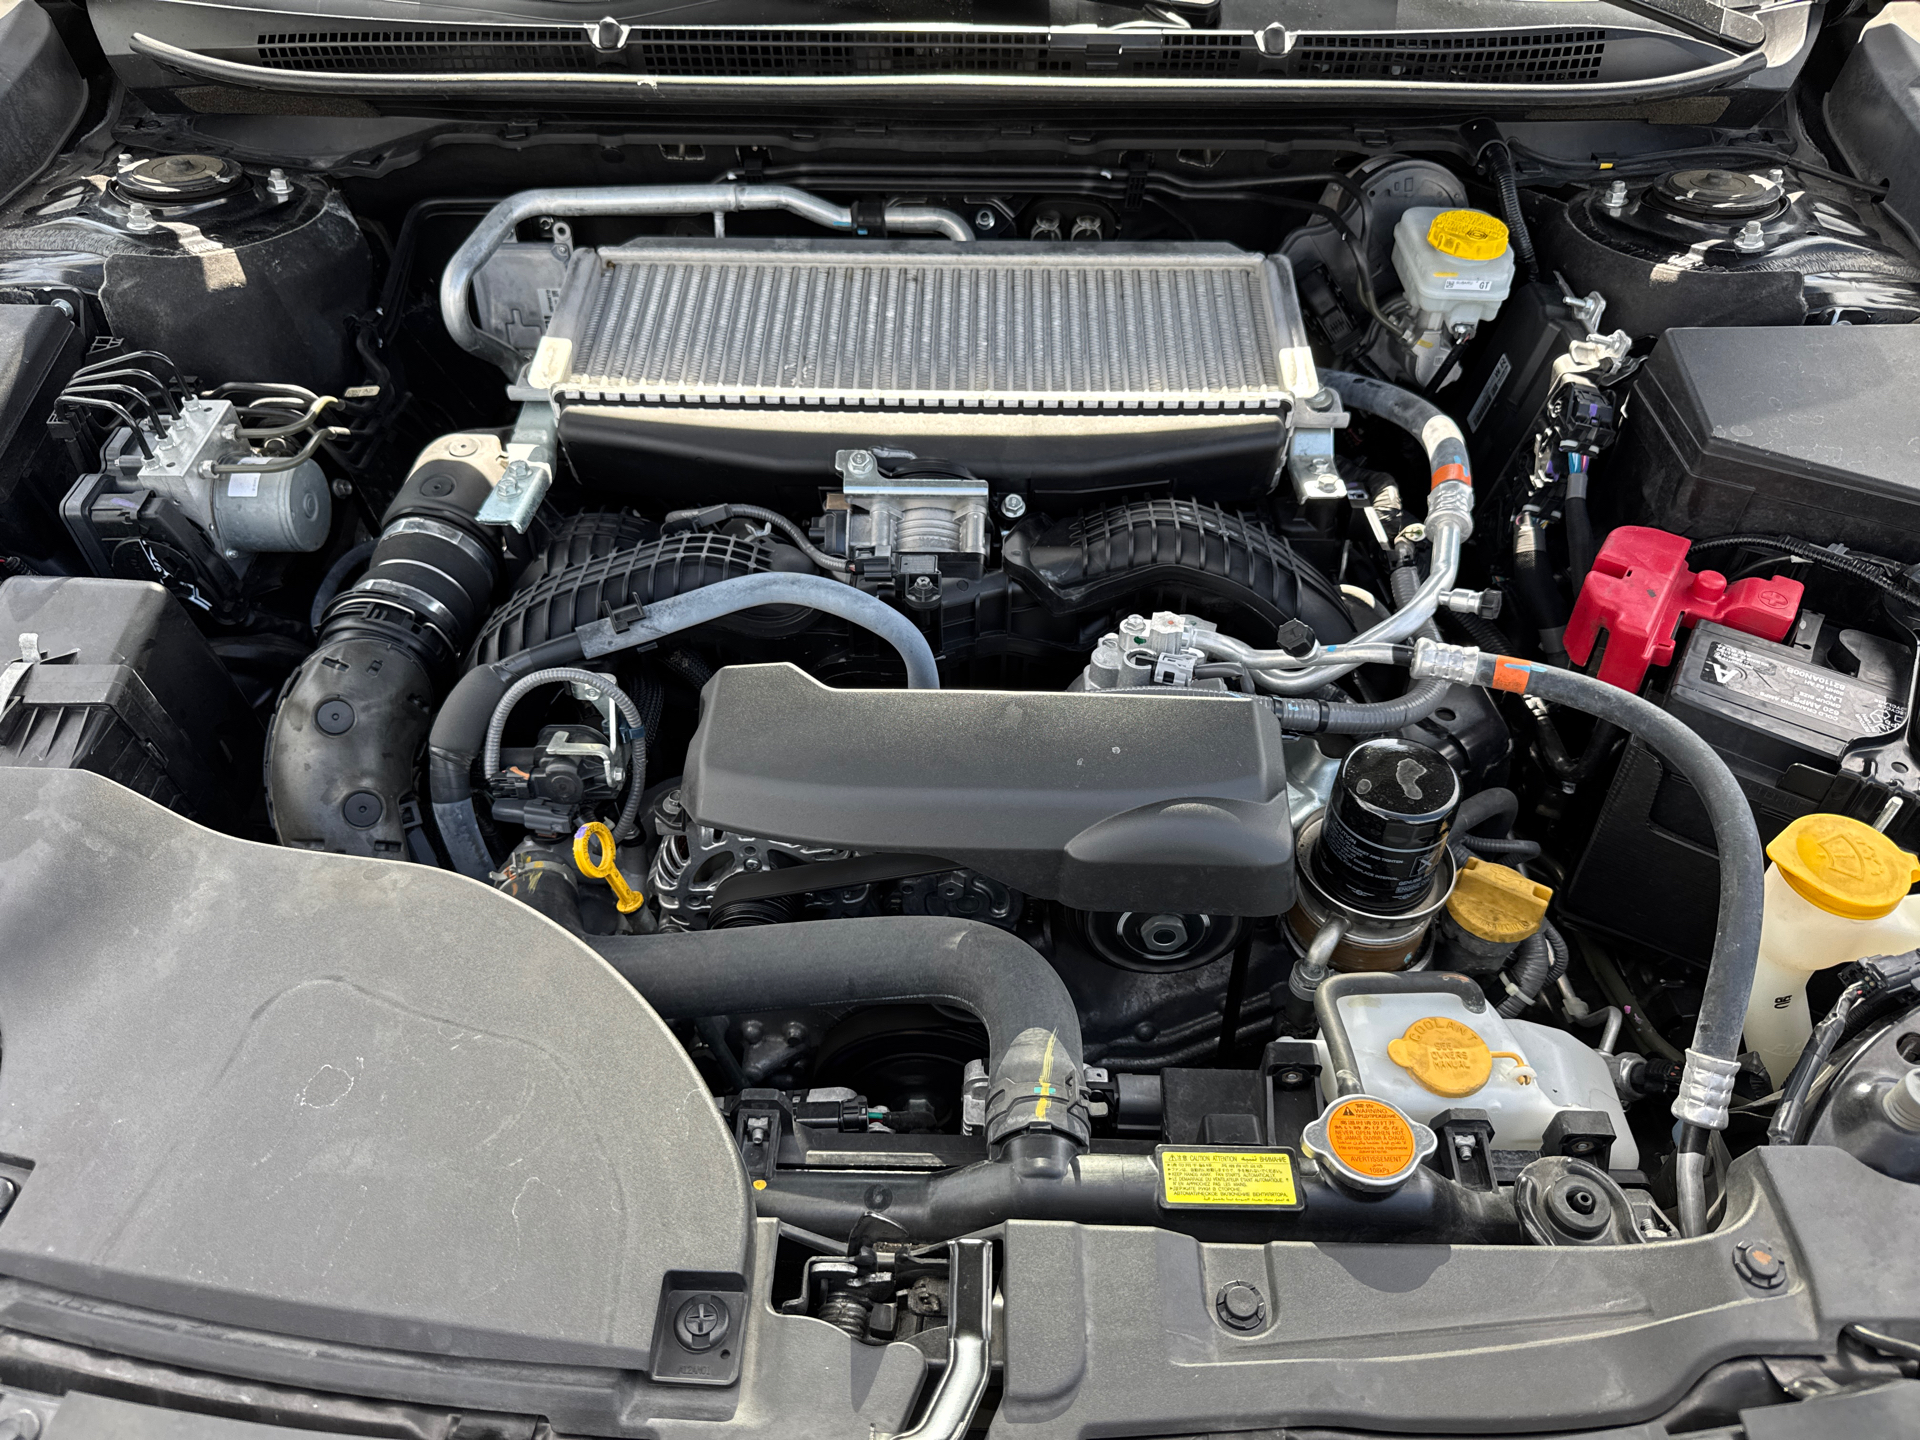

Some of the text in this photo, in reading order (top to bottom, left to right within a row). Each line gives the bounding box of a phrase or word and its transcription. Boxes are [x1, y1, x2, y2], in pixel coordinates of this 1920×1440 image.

[1816, 698, 1841, 708] GROUP
[1824, 693, 1842, 703] LN2
[1760, 692, 1838, 721] COLD CRANKING AMPS
[1794, 696, 1840, 716] 620 AMPS
[1334, 822, 1356, 844] CAUTION
[1409, 1018, 1478, 1042] COOLANT
[1434, 1042, 1453, 1051] SEE
[1433, 1061, 1470, 1069] MANUAL
